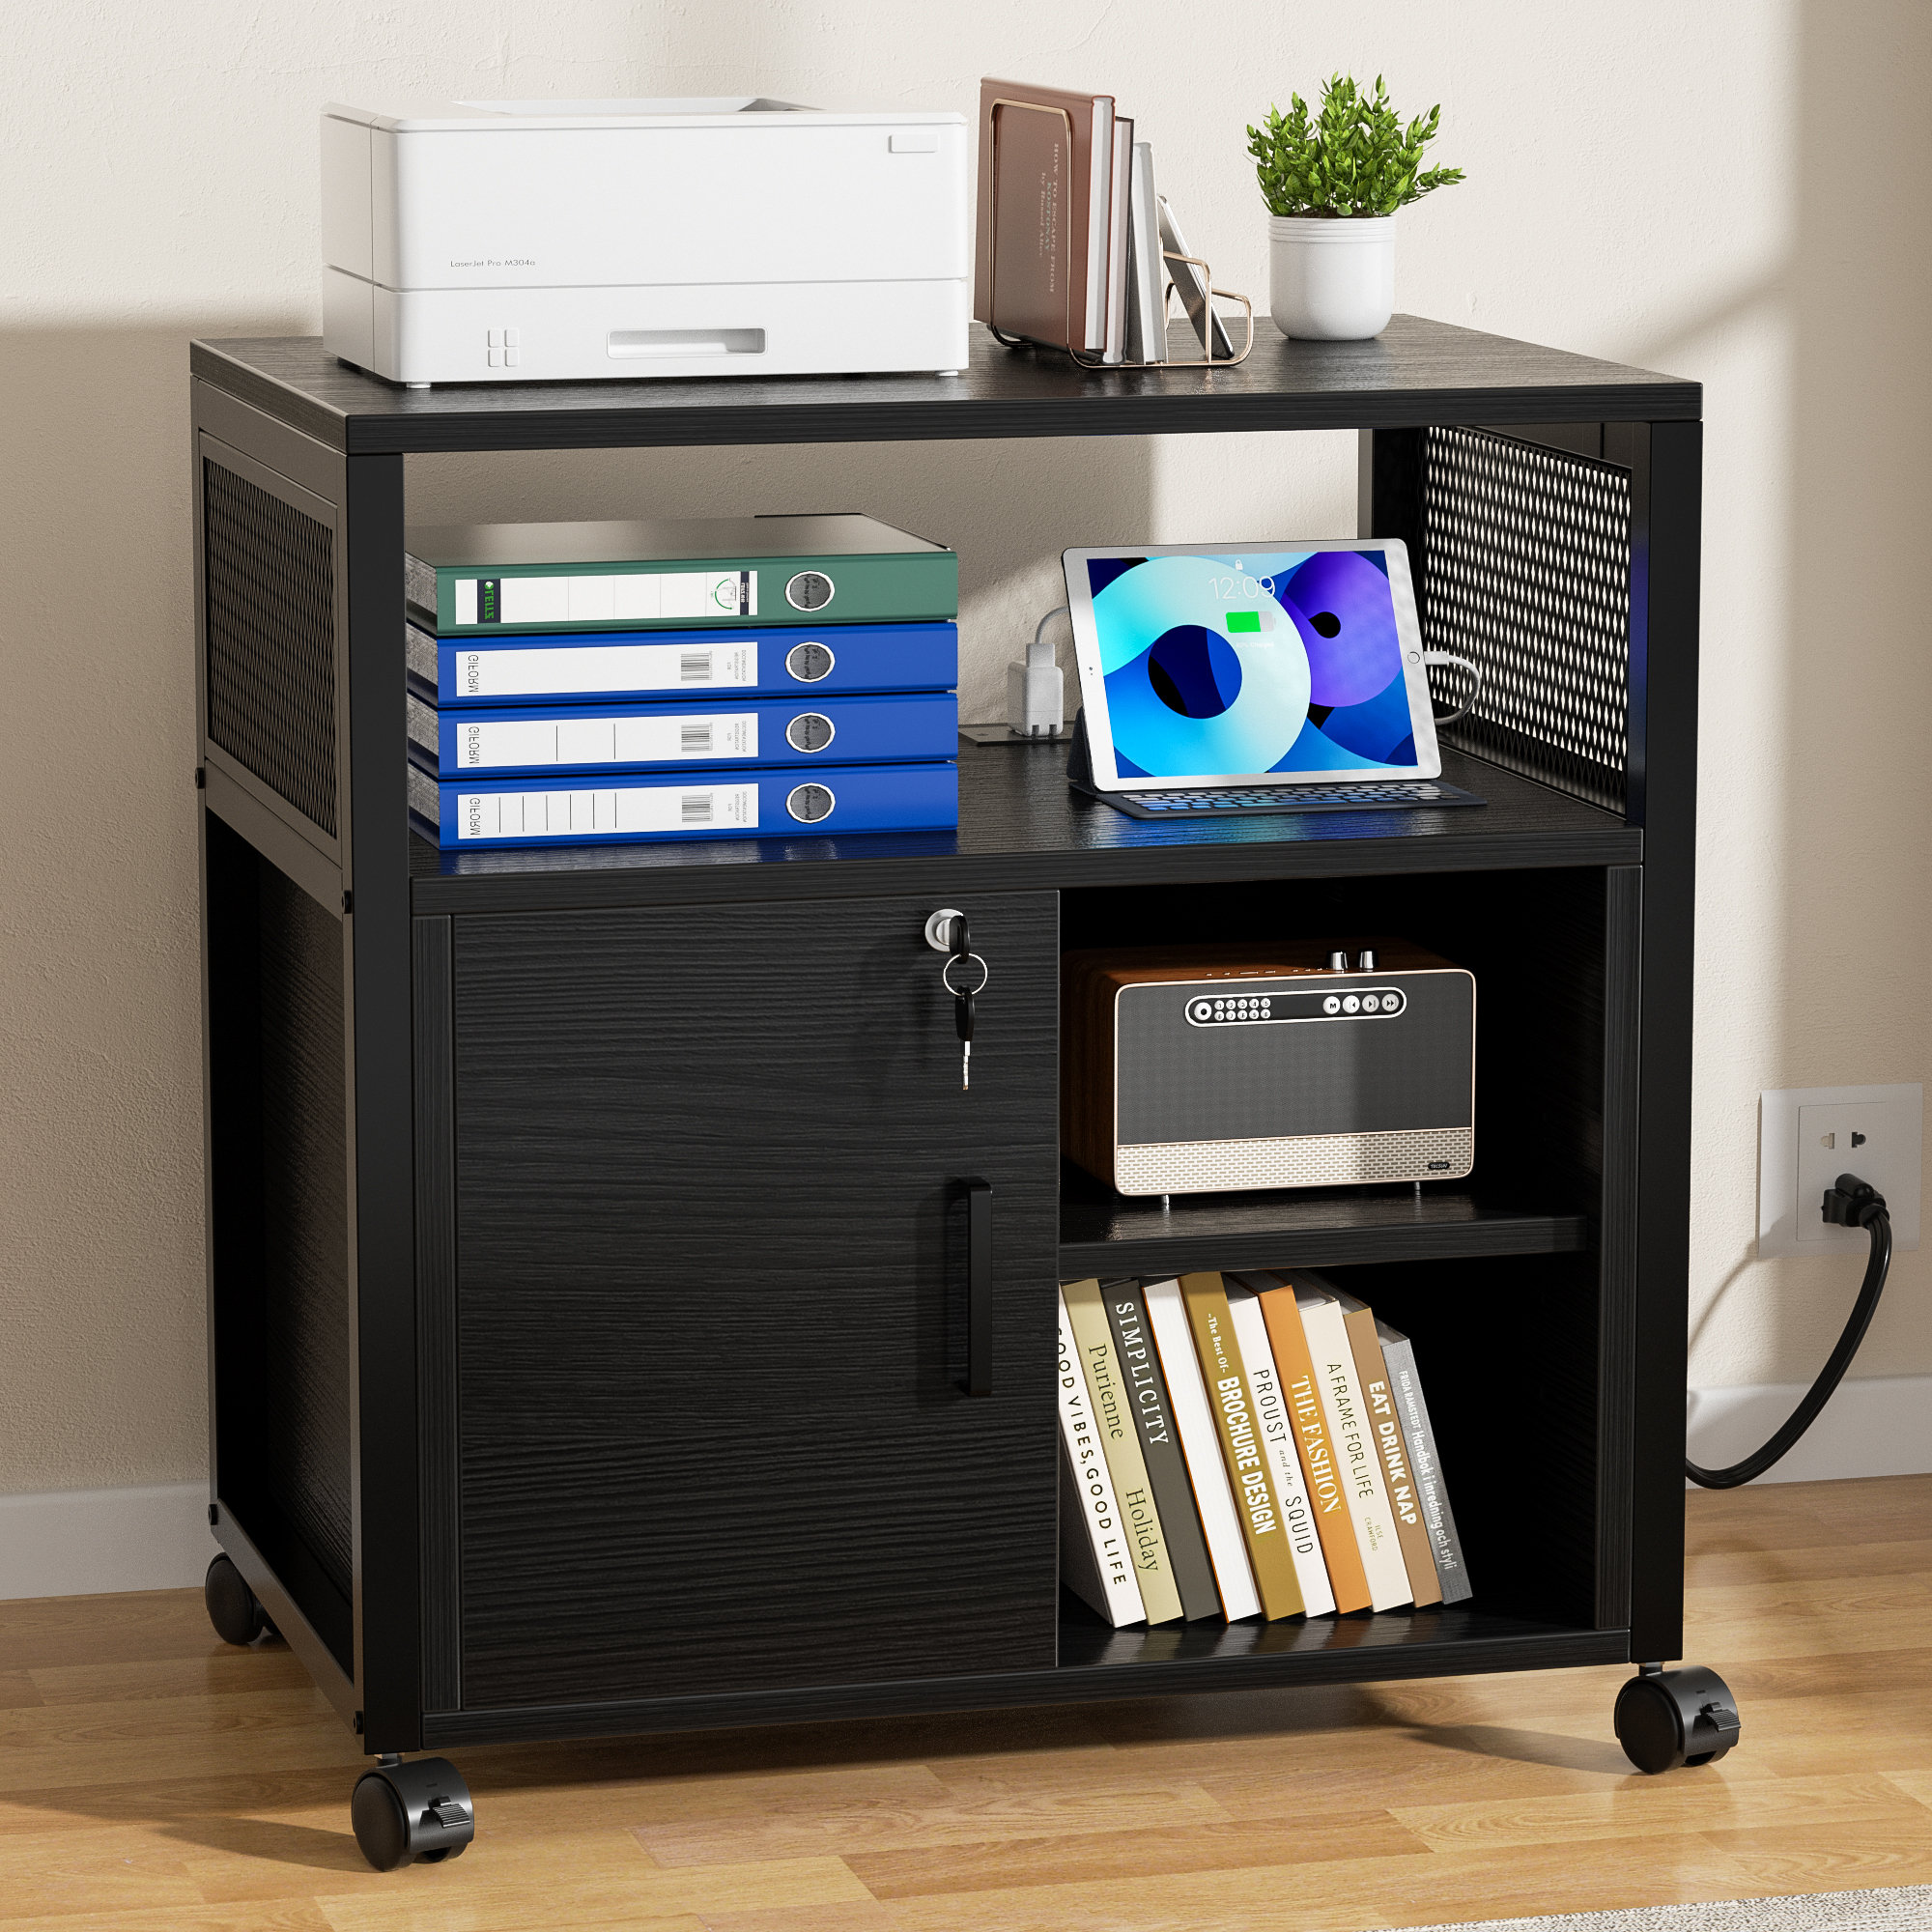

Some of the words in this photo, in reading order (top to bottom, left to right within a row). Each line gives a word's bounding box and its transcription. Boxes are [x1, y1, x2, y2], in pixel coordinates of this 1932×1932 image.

[1053, 179, 1059, 198] TO
[1208, 576, 1276, 600] 12:09
[1212, 1335, 1225, 1356] Best
[1115, 1301, 1170, 1445] SIMPLICITY
[1326, 1363, 1342, 1374] A
[1398, 1370, 1411, 1393] FRIDA
[1252, 1369, 1287, 1443] PROUST
[1291, 1375, 1319, 1422] THE
[1330, 1375, 1357, 1431] FRAME
[1368, 1380, 1392, 1415] EAT
[1404, 1391, 1422, 1429] RAMSTEDT
[1088, 1343, 1124, 1440] Purienne
[1125, 1487, 1159, 1572] Holiday
[1216, 1376, 1261, 1471] BROCHURE
[1240, 1469, 1277, 1535] DESIGN
[1278, 1449, 1291, 1467] and
[1301, 1421, 1342, 1514] FASHION
[1345, 1433, 1365, 1464] FOR
[1378, 1421, 1407, 1483] DRINK
[1411, 1430, 1435, 1476] Handbok
[1067, 1395, 1094, 1464] VIBES,
[1086, 1467, 1112, 1529] GOOD
[1103, 1538, 1127, 1585] LIFE
[1284, 1471, 1293, 1487] the
[1352, 1464, 1374, 1499] LIFE
[1393, 1485, 1417, 1525] NAP
[1423, 1480, 1444, 1530] inredning
[1285, 1495, 1314, 1554] SQUID
[1364, 1517, 1378, 1552] CRAWFORD
[1375, 1524, 1384, 1540] ILSE
[1435, 1529, 1452, 1548] och
